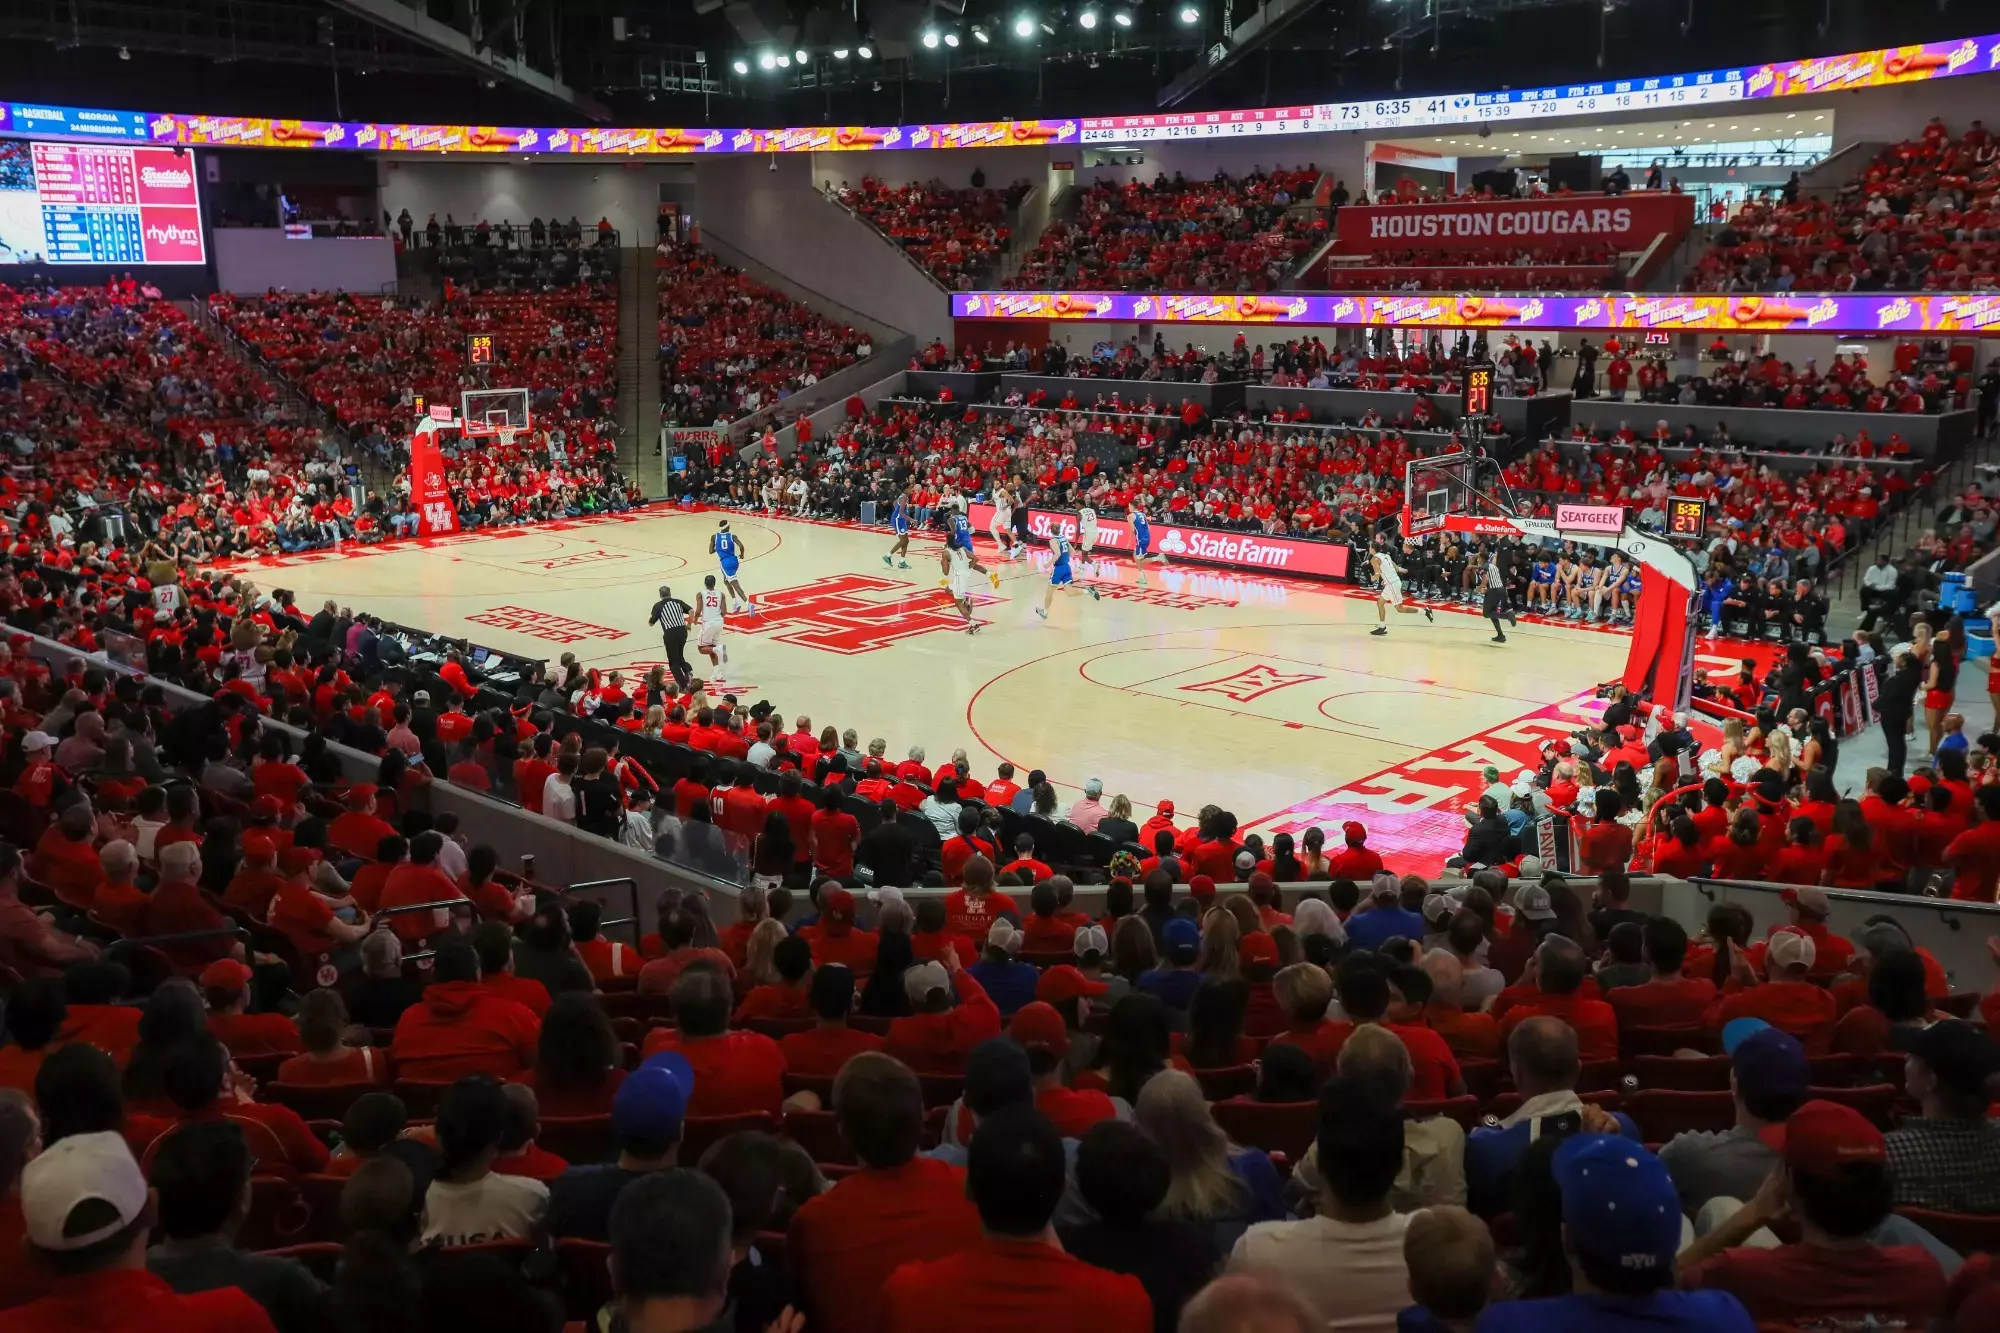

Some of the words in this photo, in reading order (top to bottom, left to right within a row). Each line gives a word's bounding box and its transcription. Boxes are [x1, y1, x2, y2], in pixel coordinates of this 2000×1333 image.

[1948, 40, 1979, 74] Takis
[1616, 82, 1631, 92] REB
[1644, 79, 1660, 90] AST
[1672, 77, 1684, 87] TO
[1697, 74, 1713, 85] BLK
[1726, 71, 1741, 81] STL
[1747, 66, 1774, 97] Takis
[1788, 65, 1802, 80] THE
[1800, 60, 1826, 84] MOST
[1812, 61, 1851, 90] INTENSE
[1341, 106, 1360, 120] 73
[1376, 101, 1410, 115] 6:35
[1427, 100, 1446, 114] 41
[1478, 107, 1510, 117] 15-39
[1531, 102, 1557, 113] 7-20
[1577, 99, 1595, 109] 4-8
[1616, 96, 1630, 106] 18
[1645, 94, 1659, 103] 11
[1670, 91, 1684, 101] 15
[1700, 88, 1708, 99] 2
[1730, 85, 1736, 96] 5
[22, 108, 66, 121] BASKETBALL
[78, 112, 119, 122] GEORGIA
[1206, 114, 1220, 122] REB
[1231, 113, 1244, 121] AST
[1275, 110, 1289, 118] BLK
[1300, 109, 1312, 117] STL
[80, 125, 127, 134] MISSISSIPPI
[1085, 130, 1114, 140] 24-48
[1125, 128, 1155, 138] 13-27
[1167, 126, 1197, 136] 12-16
[1207, 125, 1219, 134] 31
[1232, 123, 1244, 133] 12
[1256, 122, 1262, 131] 9
[1279, 121, 1285, 131] 5
[1303, 119, 1309, 129] 8
[1370, 213, 1493, 238] HOUSTON
[1496, 208, 1631, 234] COUGARS
[147, 224, 198, 244] rhythm
[1096, 296, 1113, 317] Takis
[1133, 296, 1151, 318] Takis
[1288, 297, 1307, 320] Takis
[1332, 298, 1354, 321] Takis
[1382, 299, 1402, 316] MOST
[1393, 302, 1425, 322] INTENSE
[1519, 299, 1544, 324] Takis
[1574, 299, 1601, 325] Takis
[1635, 300, 1660, 319] MOST
[1649, 303, 1687, 326] INTENSE
[1808, 298, 1839, 328] Takis
[1876, 298, 1911, 328] Takis
[1942, 300, 1960, 314] THE
[1956, 298, 1990, 320] MOST
[1973, 308, 2000, 328] INTE
[474, 337, 491, 347] 6:35
[472, 346, 490, 362] 27
[1472, 372, 1488, 386] 6:35
[1469, 387, 1486, 413] 27
[674, 430, 719, 442] MARRS
[424, 502, 453, 532] UH
[1086, 513, 1095, 522] 23
[1139, 515, 1146, 526] 3
[1560, 511, 1618, 526] SEATGEEK
[1677, 503, 1701, 517] 6:35
[959, 518, 968, 531] 13
[1675, 516, 1696, 531] 27
[721, 539, 728, 550] 0
[161, 591, 173, 604] 27
[707, 596, 718, 608] 25
[464, 614, 587, 643] CENTER
[486, 605, 631, 640] FERTITTA
[1862, 664, 1881, 724] DENSE
[713, 796, 724, 815] 10
[1541, 821, 1556, 870] PAWS
